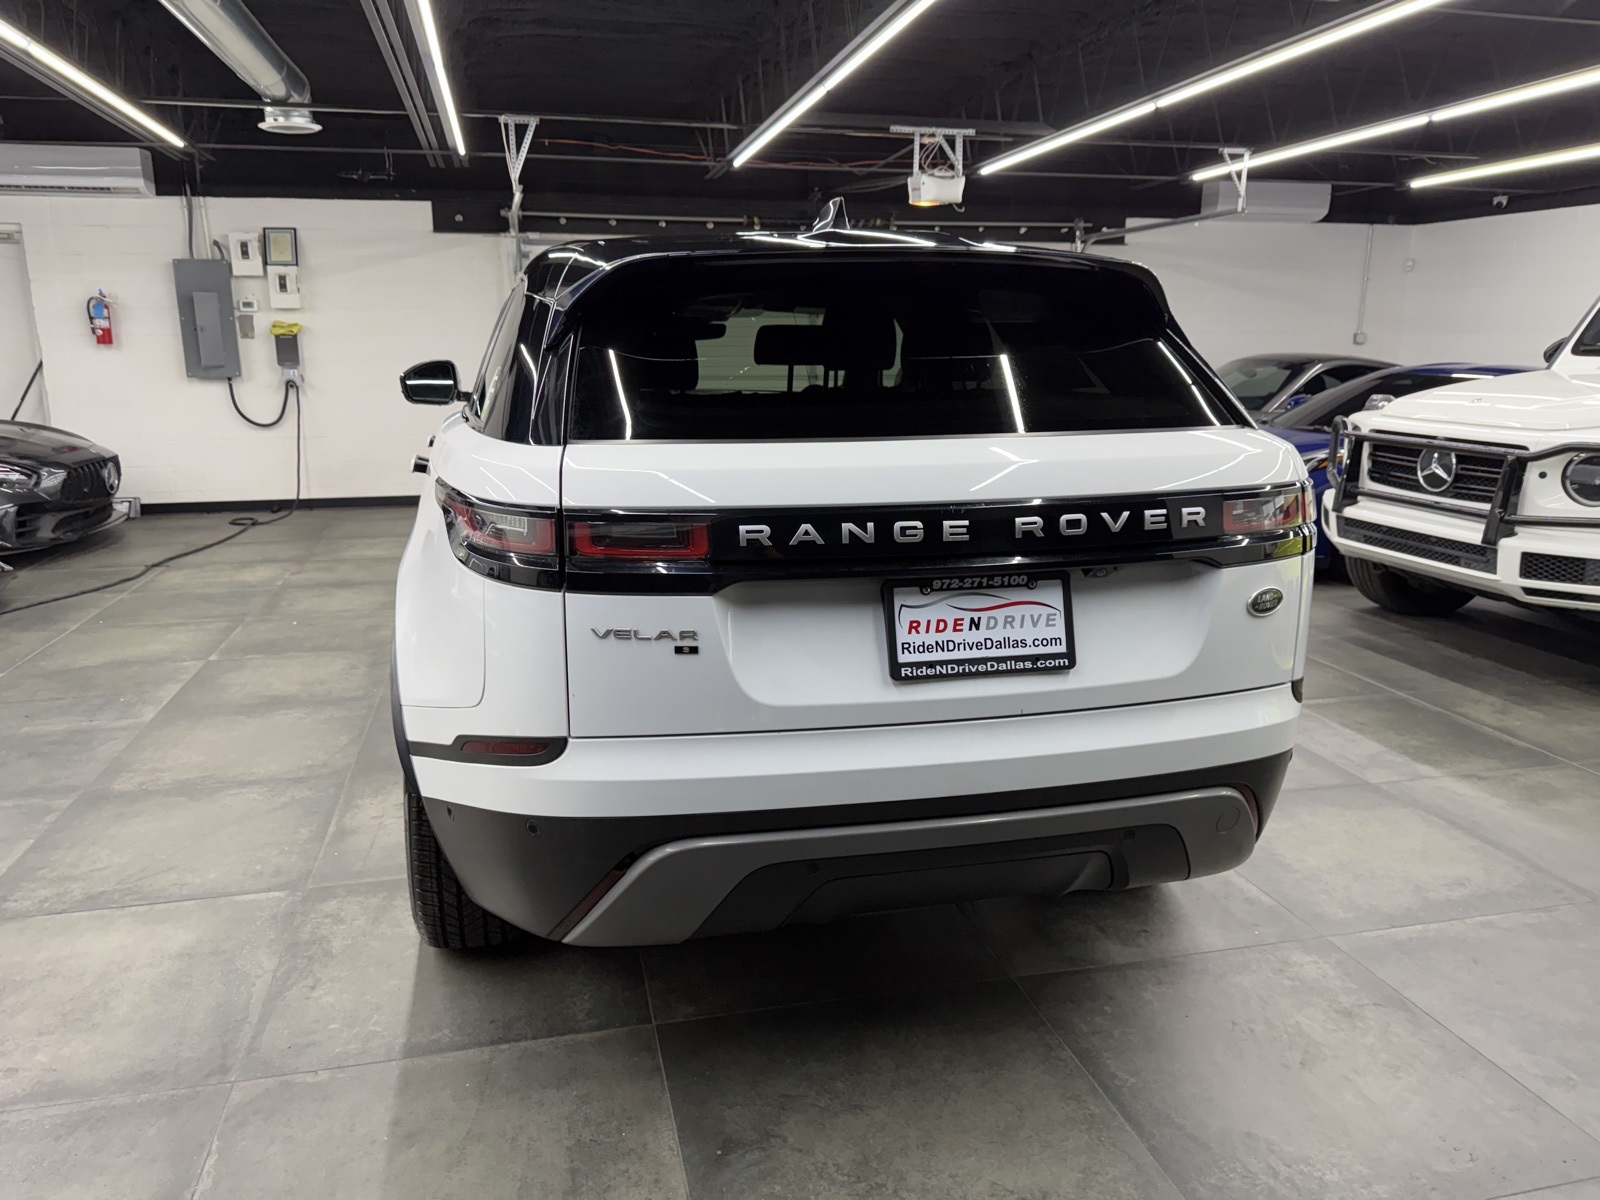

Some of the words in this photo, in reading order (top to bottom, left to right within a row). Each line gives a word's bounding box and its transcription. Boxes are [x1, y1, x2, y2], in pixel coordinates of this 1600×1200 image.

[738, 520, 970, 547] RANGE
[1014, 506, 1206, 539] ROVER
[932, 575, 1028, 590] 972-271-5100
[590, 627, 699, 641] VELAR
[901, 636, 1063, 655] RideNDriveDallas.com
[901, 658, 1069, 677] RideNDriveDallas.com
